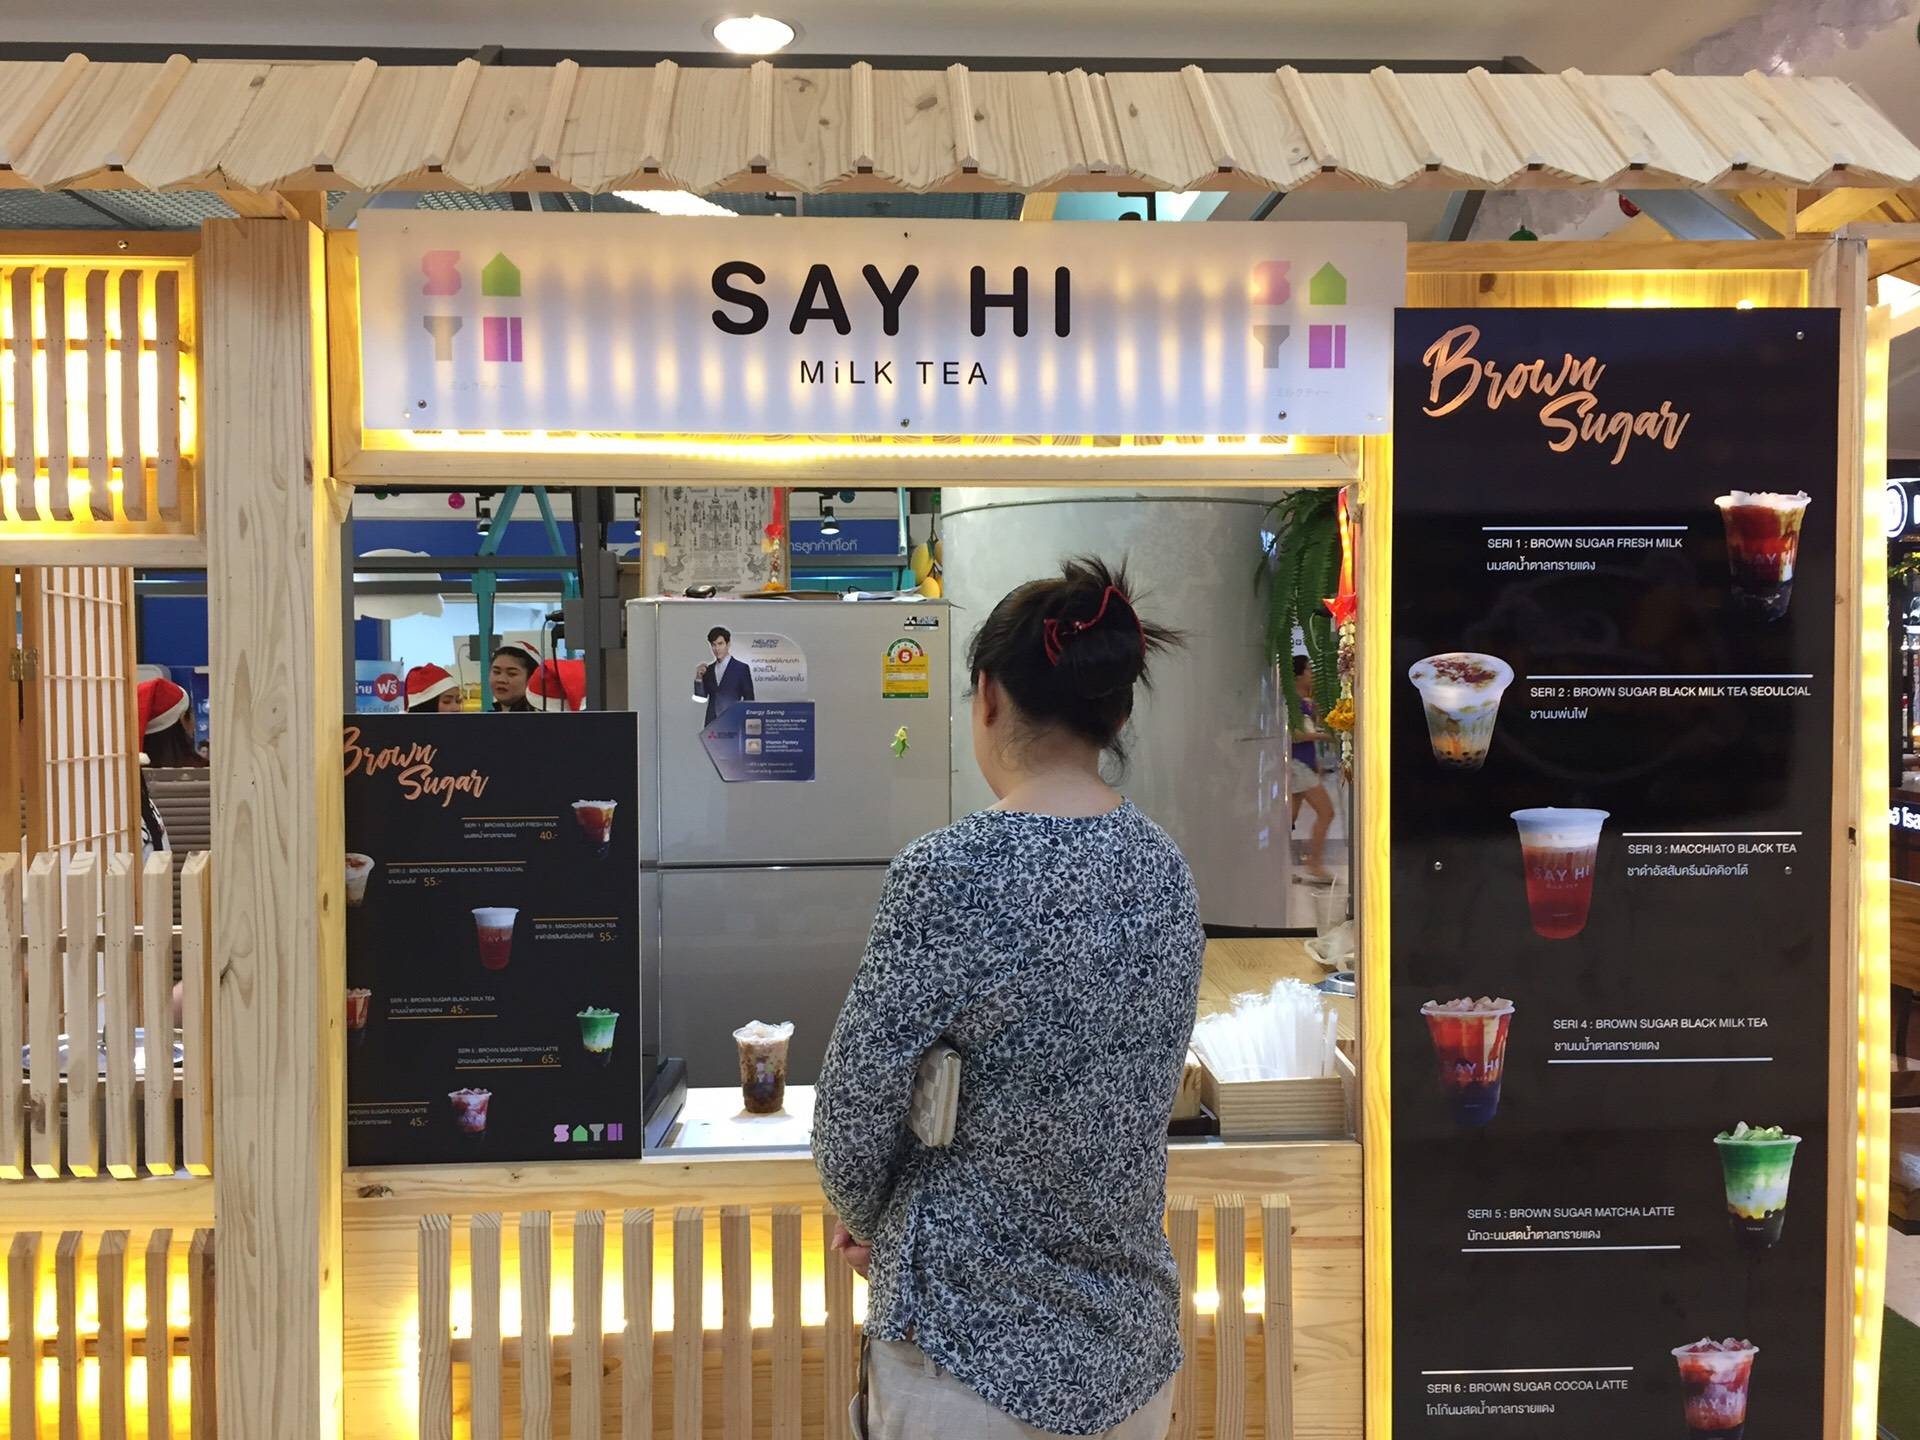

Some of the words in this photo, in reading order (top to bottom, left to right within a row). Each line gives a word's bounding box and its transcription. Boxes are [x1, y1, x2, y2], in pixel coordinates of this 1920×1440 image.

[711, 261, 920, 337] SAY
[970, 265, 1071, 338] HI
[800, 360, 893, 385] MiLK
[915, 361, 988, 386] TEA
[1422, 324, 1607, 418] Brown
[1538, 390, 1691, 465] Sugar
[1487, 538, 1513, 549] SERI
[1515, 538, 1521, 549] 1
[1530, 538, 1573, 549] BROWN
[1575, 537, 1615, 549] SUGAR
[1616, 537, 1654, 548] FRESH
[1655, 537, 1683, 548] MILK
[377, 679, 398, 695] ฟรี
[1530, 687, 1556, 698] SERI
[1558, 687, 1565, 698] 2
[1573, 686, 1616, 697] BROWN
[1617, 686, 1658, 697] SUGAR
[1659, 686, 1697, 697] BLACK
[1698, 686, 1725, 697] MILK
[1726, 686, 1749, 697] TEA
[1749, 685, 1812, 697] SEOULCIAL
[1530, 706, 1589, 720] ชานมพ่นไฟ
[344, 726, 438, 776] Brown
[398, 764, 489, 808] Sugar
[1627, 844, 1653, 855] SERI
[1655, 844, 1663, 855] 3
[1670, 843, 1736, 854] MACCHIATO
[1737, 843, 1774, 854] BLACK
[1775, 843, 1797, 854] TEA
[1553, 1019, 1578, 1030] SERI
[1580, 1019, 1588, 1030] 4
[1595, 1018, 1638, 1029] BROWN
[1639, 1018, 1679, 1029] SUGAR
[1680, 1017, 1717, 1029] BLACK
[1719, 1017, 1746, 1028] MILK
[1747, 1017, 1769, 1028] TEA
[1467, 1209, 1492, 1220] SERI
[1494, 1209, 1502, 1220] 5
[1509, 1208, 1551, 1219] BROWN
[1553, 1207, 1593, 1219] SUGAR
[1594, 1206, 1641, 1218] MATCHA
[1642, 1206, 1675, 1217] LATTE
[1427, 1383, 1452, 1394] SERI
[1454, 1383, 1462, 1394] 6
[1469, 1382, 1511, 1393] BROWN
[1512, 1381, 1552, 1392] SUGAR
[1553, 1380, 1594, 1392] COCOA
[1596, 1379, 1628, 1391] LATTE
